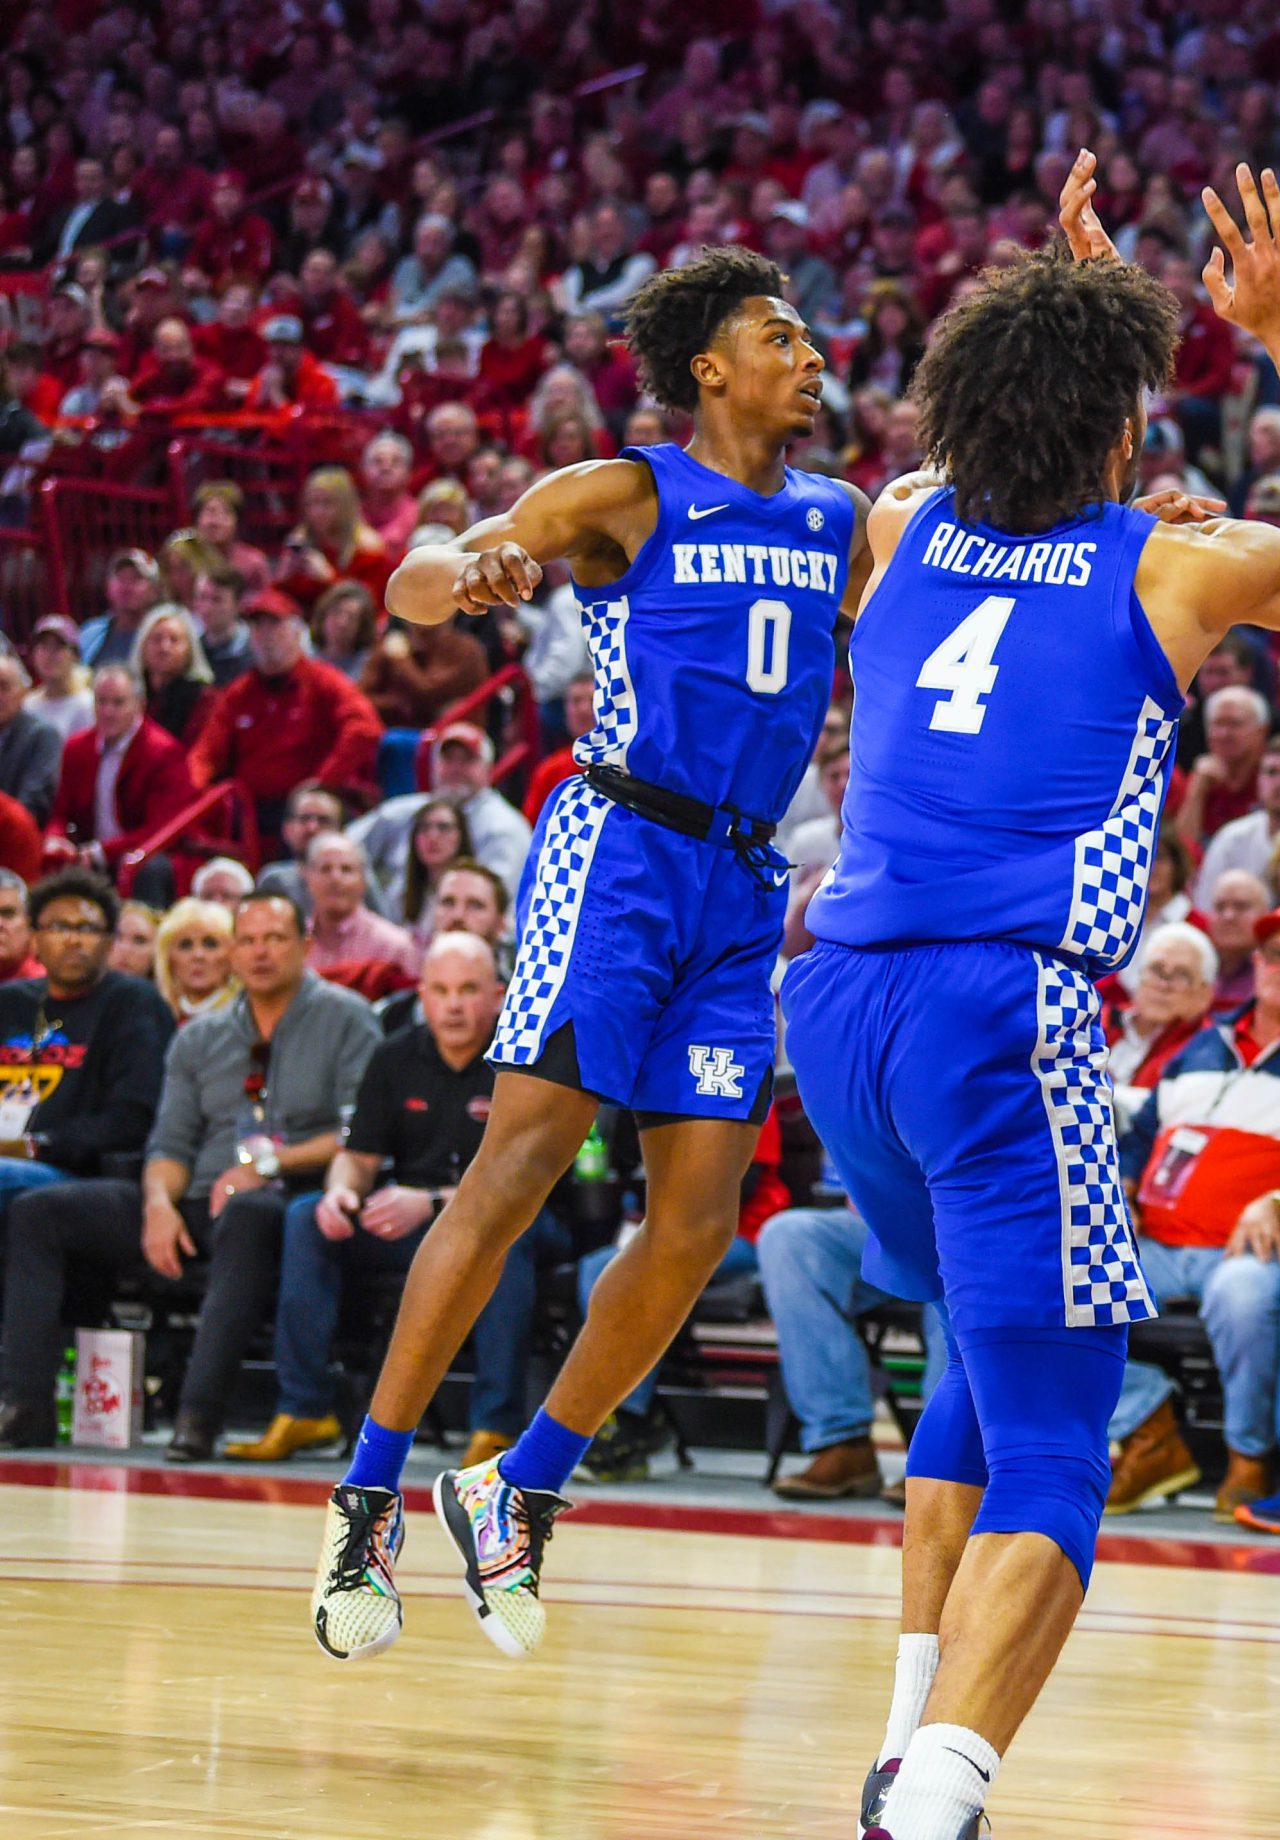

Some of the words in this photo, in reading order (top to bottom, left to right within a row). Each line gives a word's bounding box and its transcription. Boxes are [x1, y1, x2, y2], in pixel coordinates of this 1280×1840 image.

[672, 544, 838, 594] KENTUCKY
[921, 522, 1097, 586] RICHARDS
[746, 599, 792, 694] 0
[915, 595, 1016, 734] 4
[688, 1045, 745, 1098] UK
